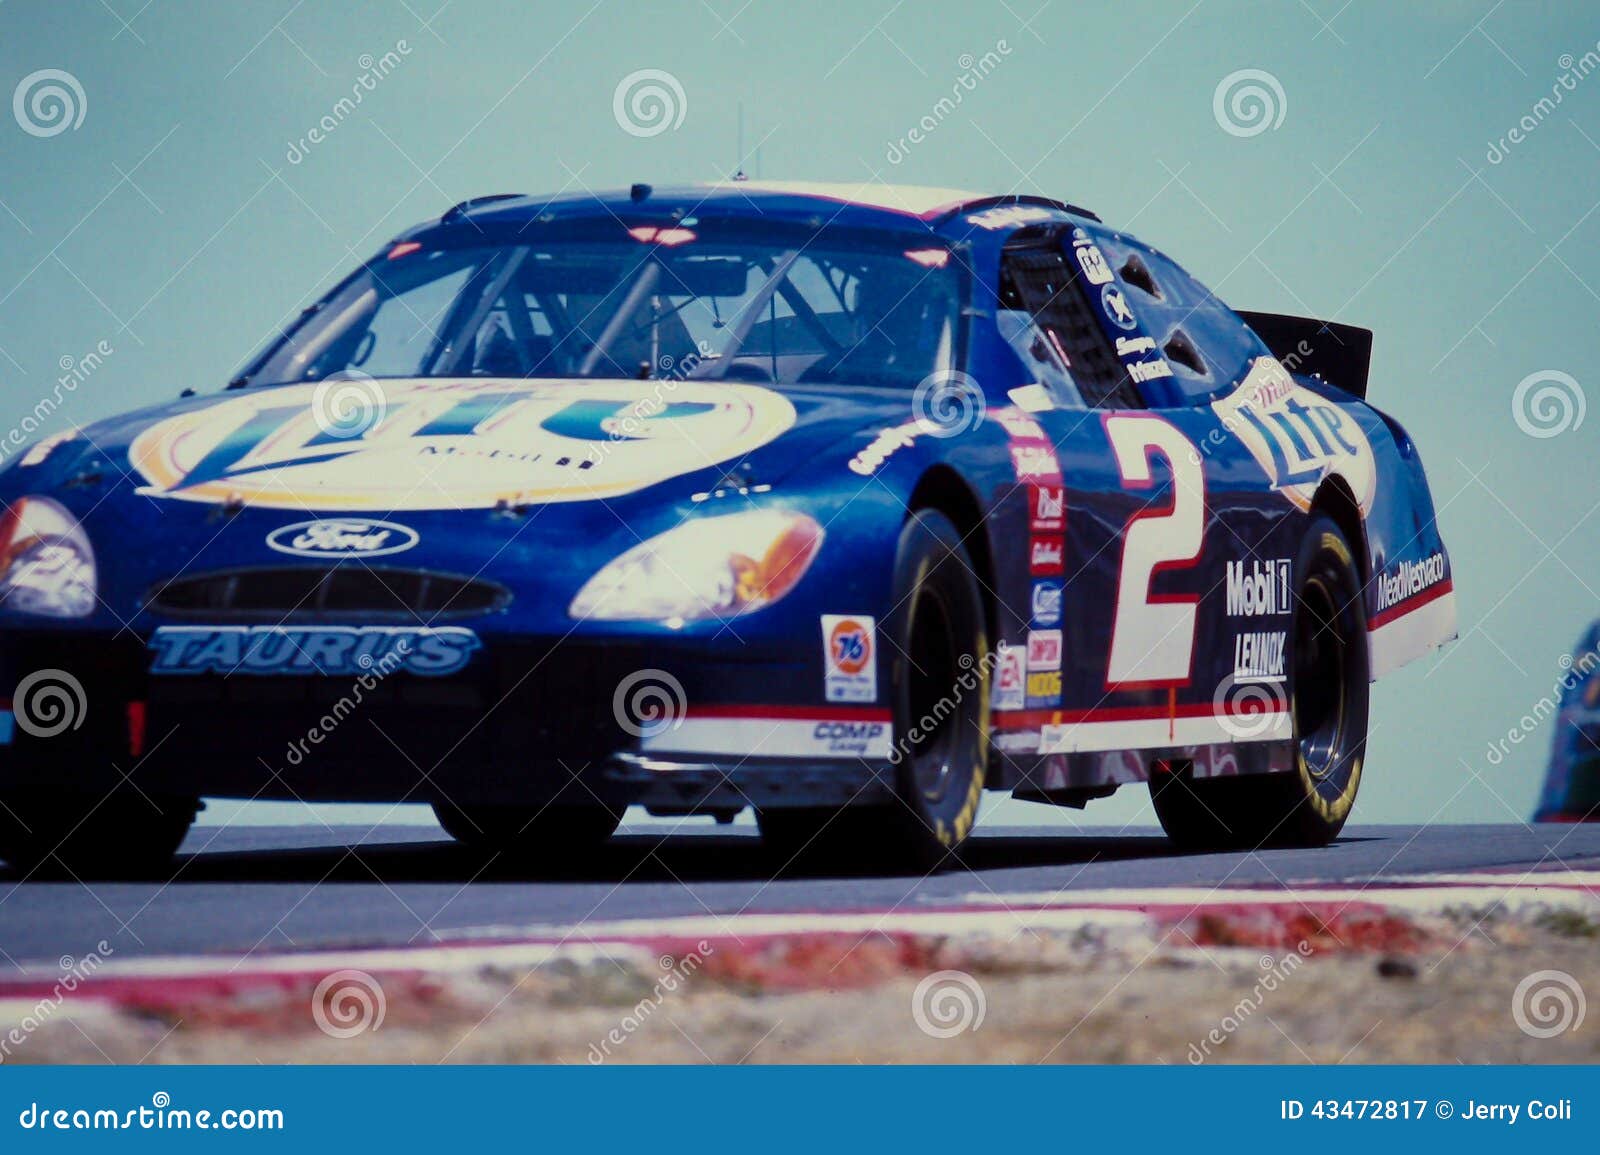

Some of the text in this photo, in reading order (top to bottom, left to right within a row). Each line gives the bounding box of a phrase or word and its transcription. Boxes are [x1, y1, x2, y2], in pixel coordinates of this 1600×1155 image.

[292, 521, 391, 550] Ford
[1100, 411, 1207, 692] 2
[1226, 559, 1290, 616] Mobil 1
[1376, 552, 1444, 612] MeadWestvaco
[150, 626, 480, 675] TAURUS
[838, 633, 863, 660] 76
[1233, 631, 1287, 677] LENNOX
[813, 722, 884, 740] COMP
